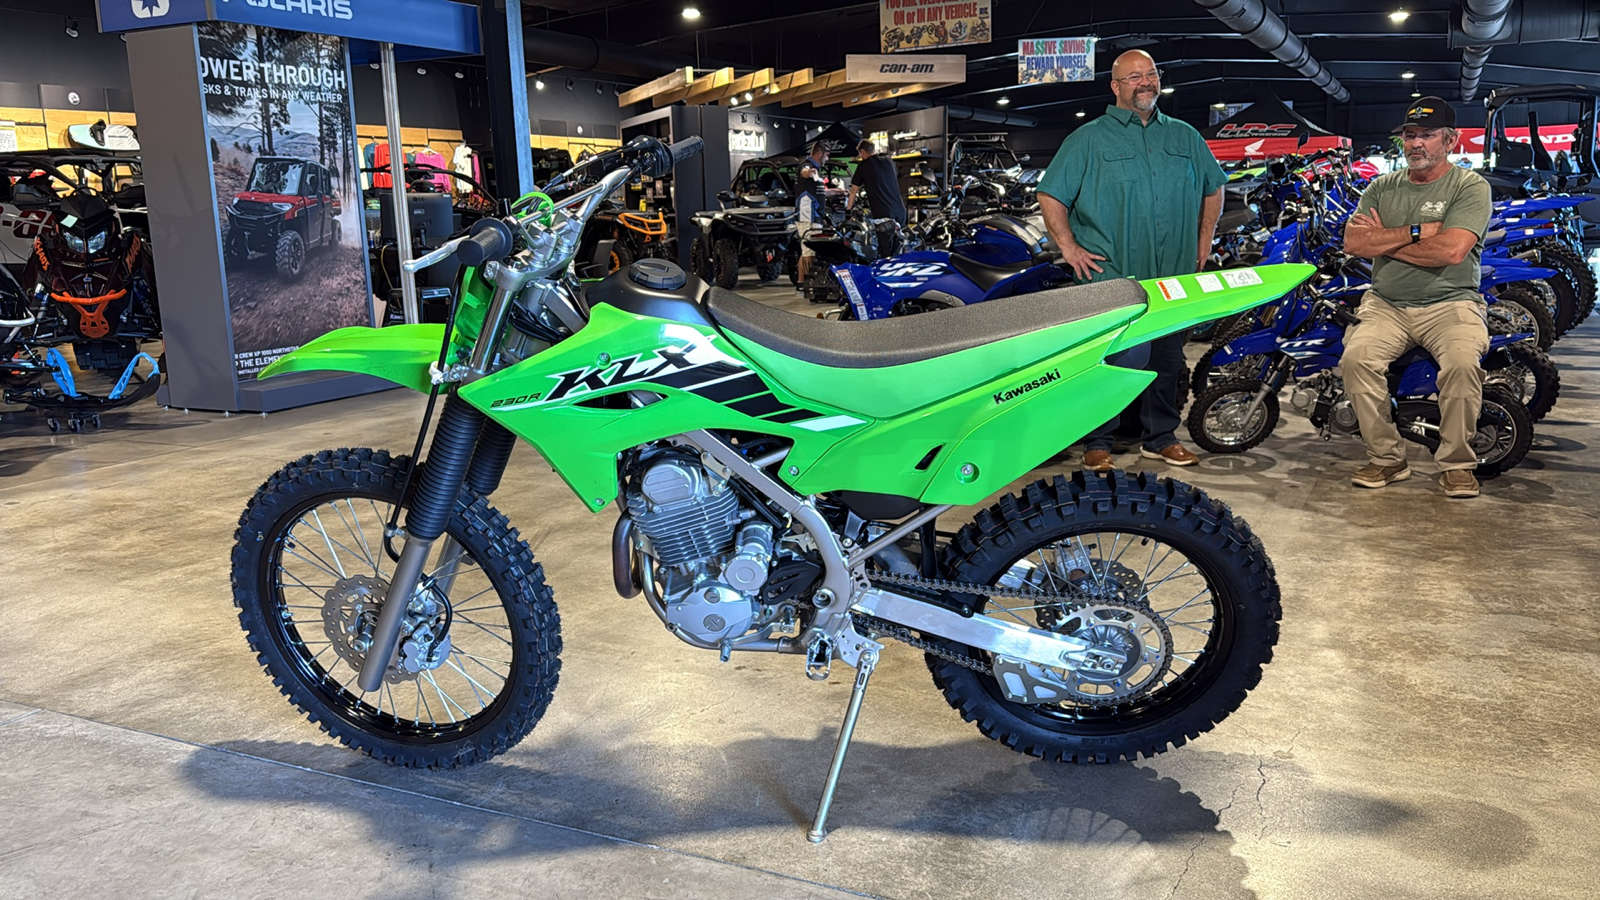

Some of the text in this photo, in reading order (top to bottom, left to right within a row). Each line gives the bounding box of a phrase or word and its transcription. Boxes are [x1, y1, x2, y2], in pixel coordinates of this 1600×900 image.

[894, 11, 904, 26] ON
[906, 12, 915, 24] or
[917, 8, 925, 23] IN
[927, 6, 943, 22] ANY
[945, 2, 978, 20] VEHICLE
[879, 63, 935, 73] can-am
[1026, 56, 1055, 71] REWARD
[1056, 55, 1087, 69] YOURSELF
[200, 57, 346, 89] OWER THROUGH
[203, 83, 343, 103] SKS & TRAILS IN ANY WEATHER
[879, 262, 948, 276] YFZ
[240, 359, 254, 368] THE
[547, 340, 708, 401] KLX
[993, 368, 1062, 405] Kawasaki
[490, 392, 541, 408] 230R
